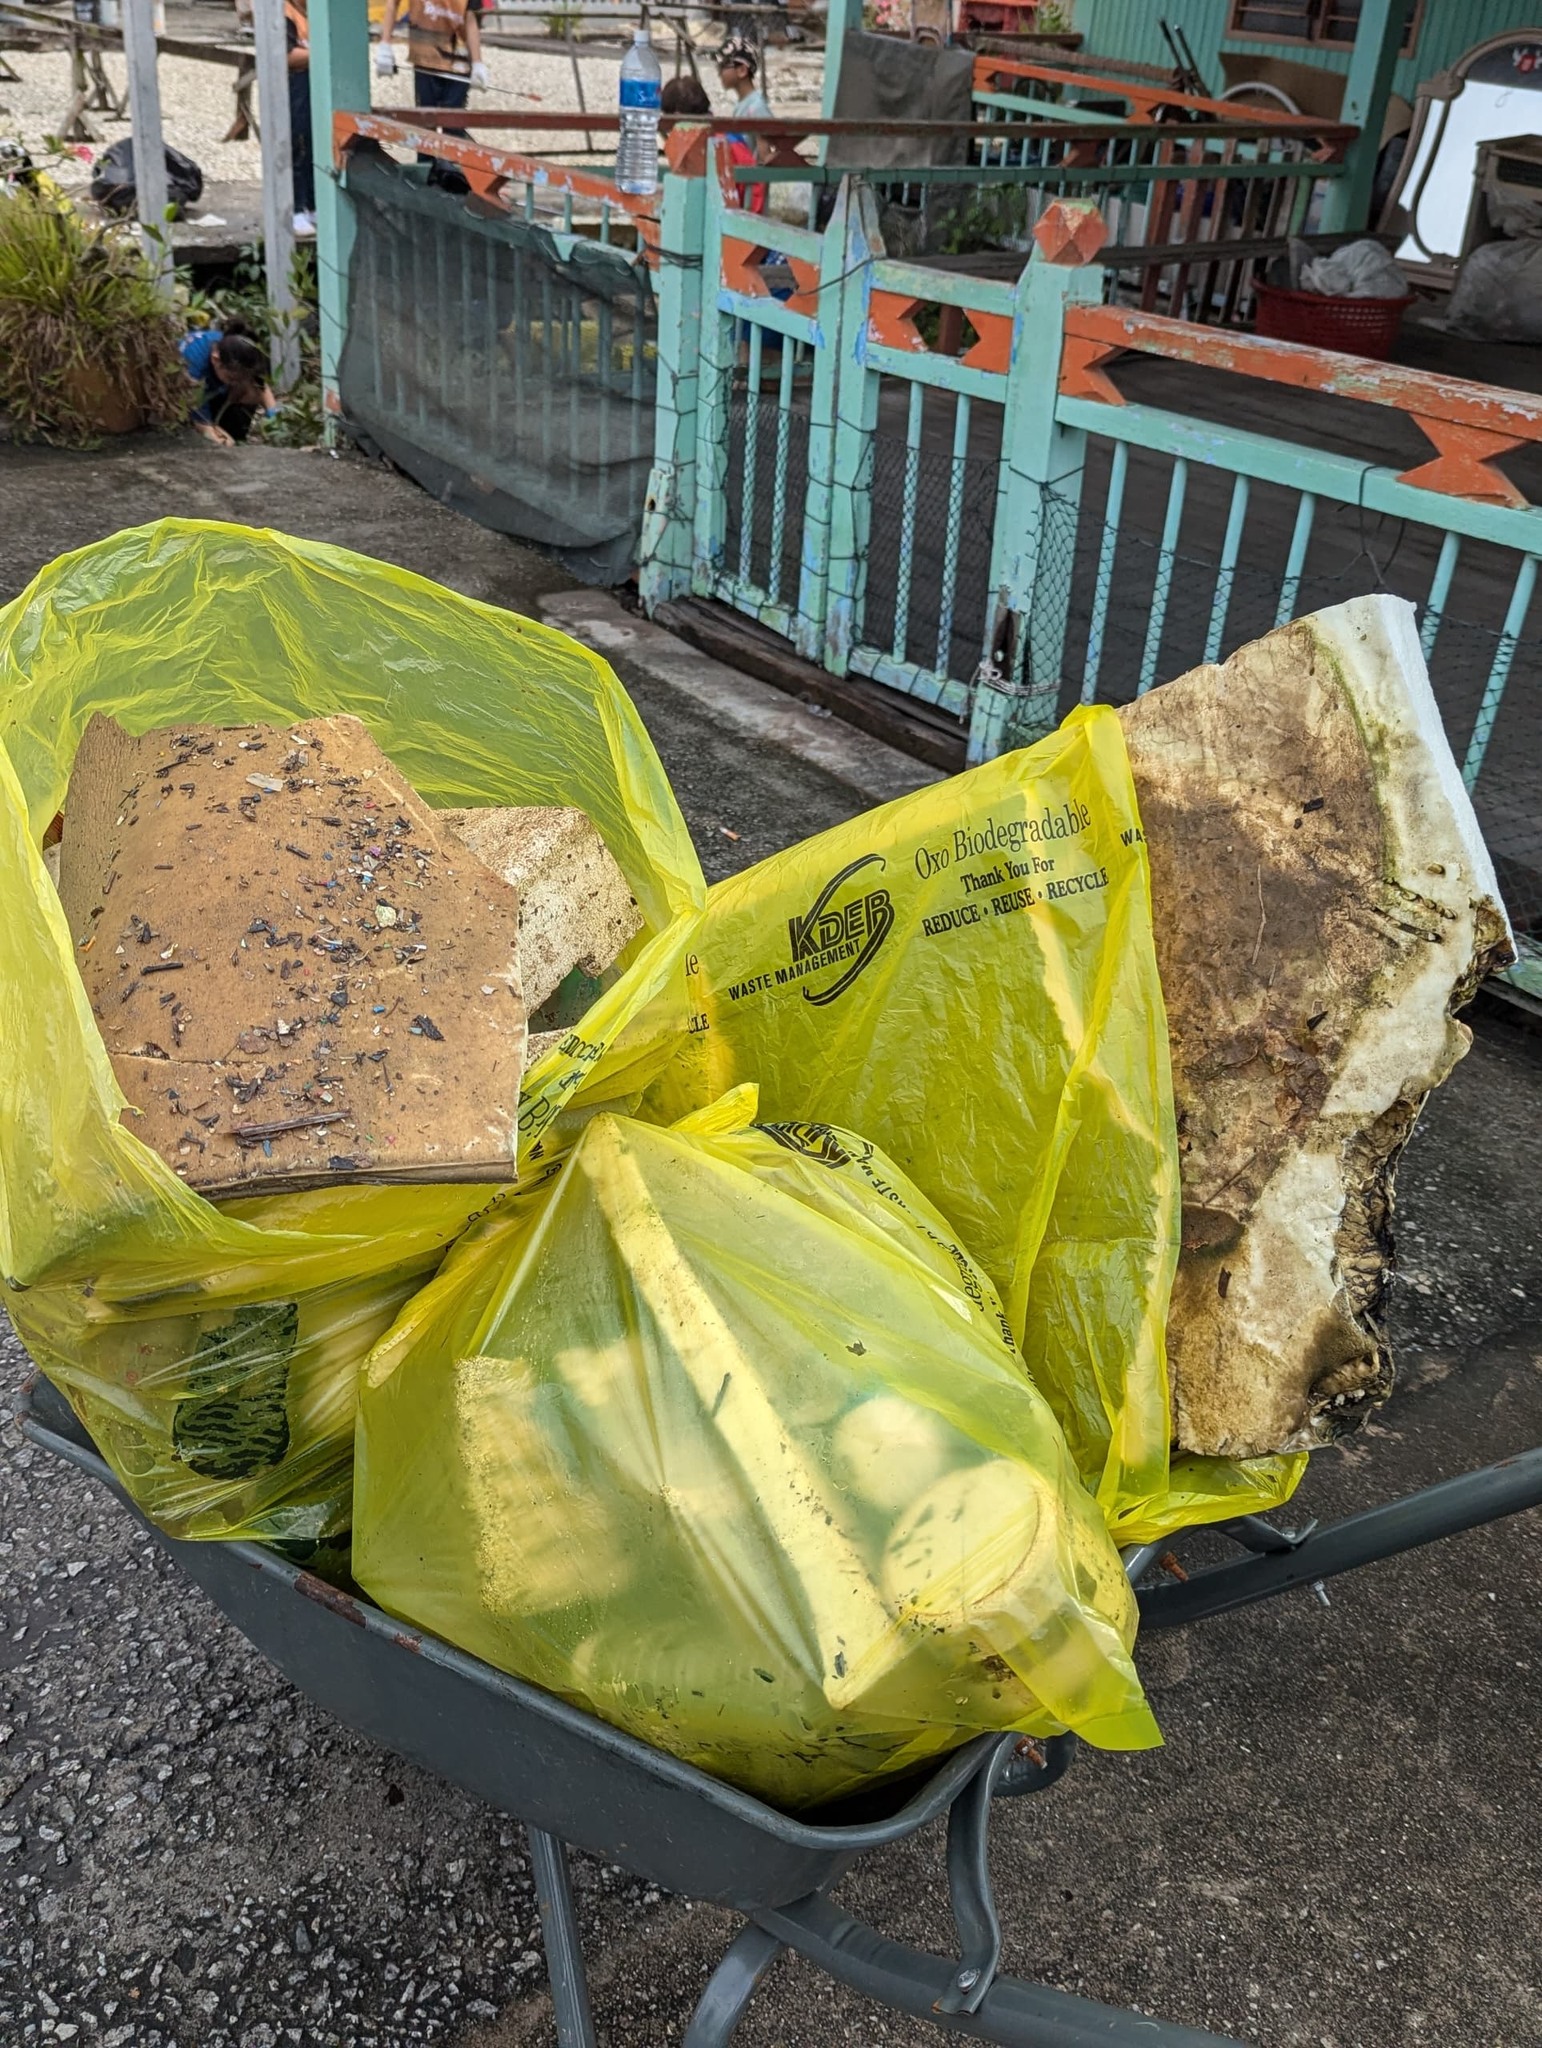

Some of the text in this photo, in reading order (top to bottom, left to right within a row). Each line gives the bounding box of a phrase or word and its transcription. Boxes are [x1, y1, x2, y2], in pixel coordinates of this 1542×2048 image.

[915, 798, 1092, 880] Oxo Biodegradable
[922, 867, 1110, 937] REDUCE REUSE RECYCLE
[960, 856, 1055, 896] Thank You For
[728, 939, 861, 1001] WASTE MANAGEMENT
